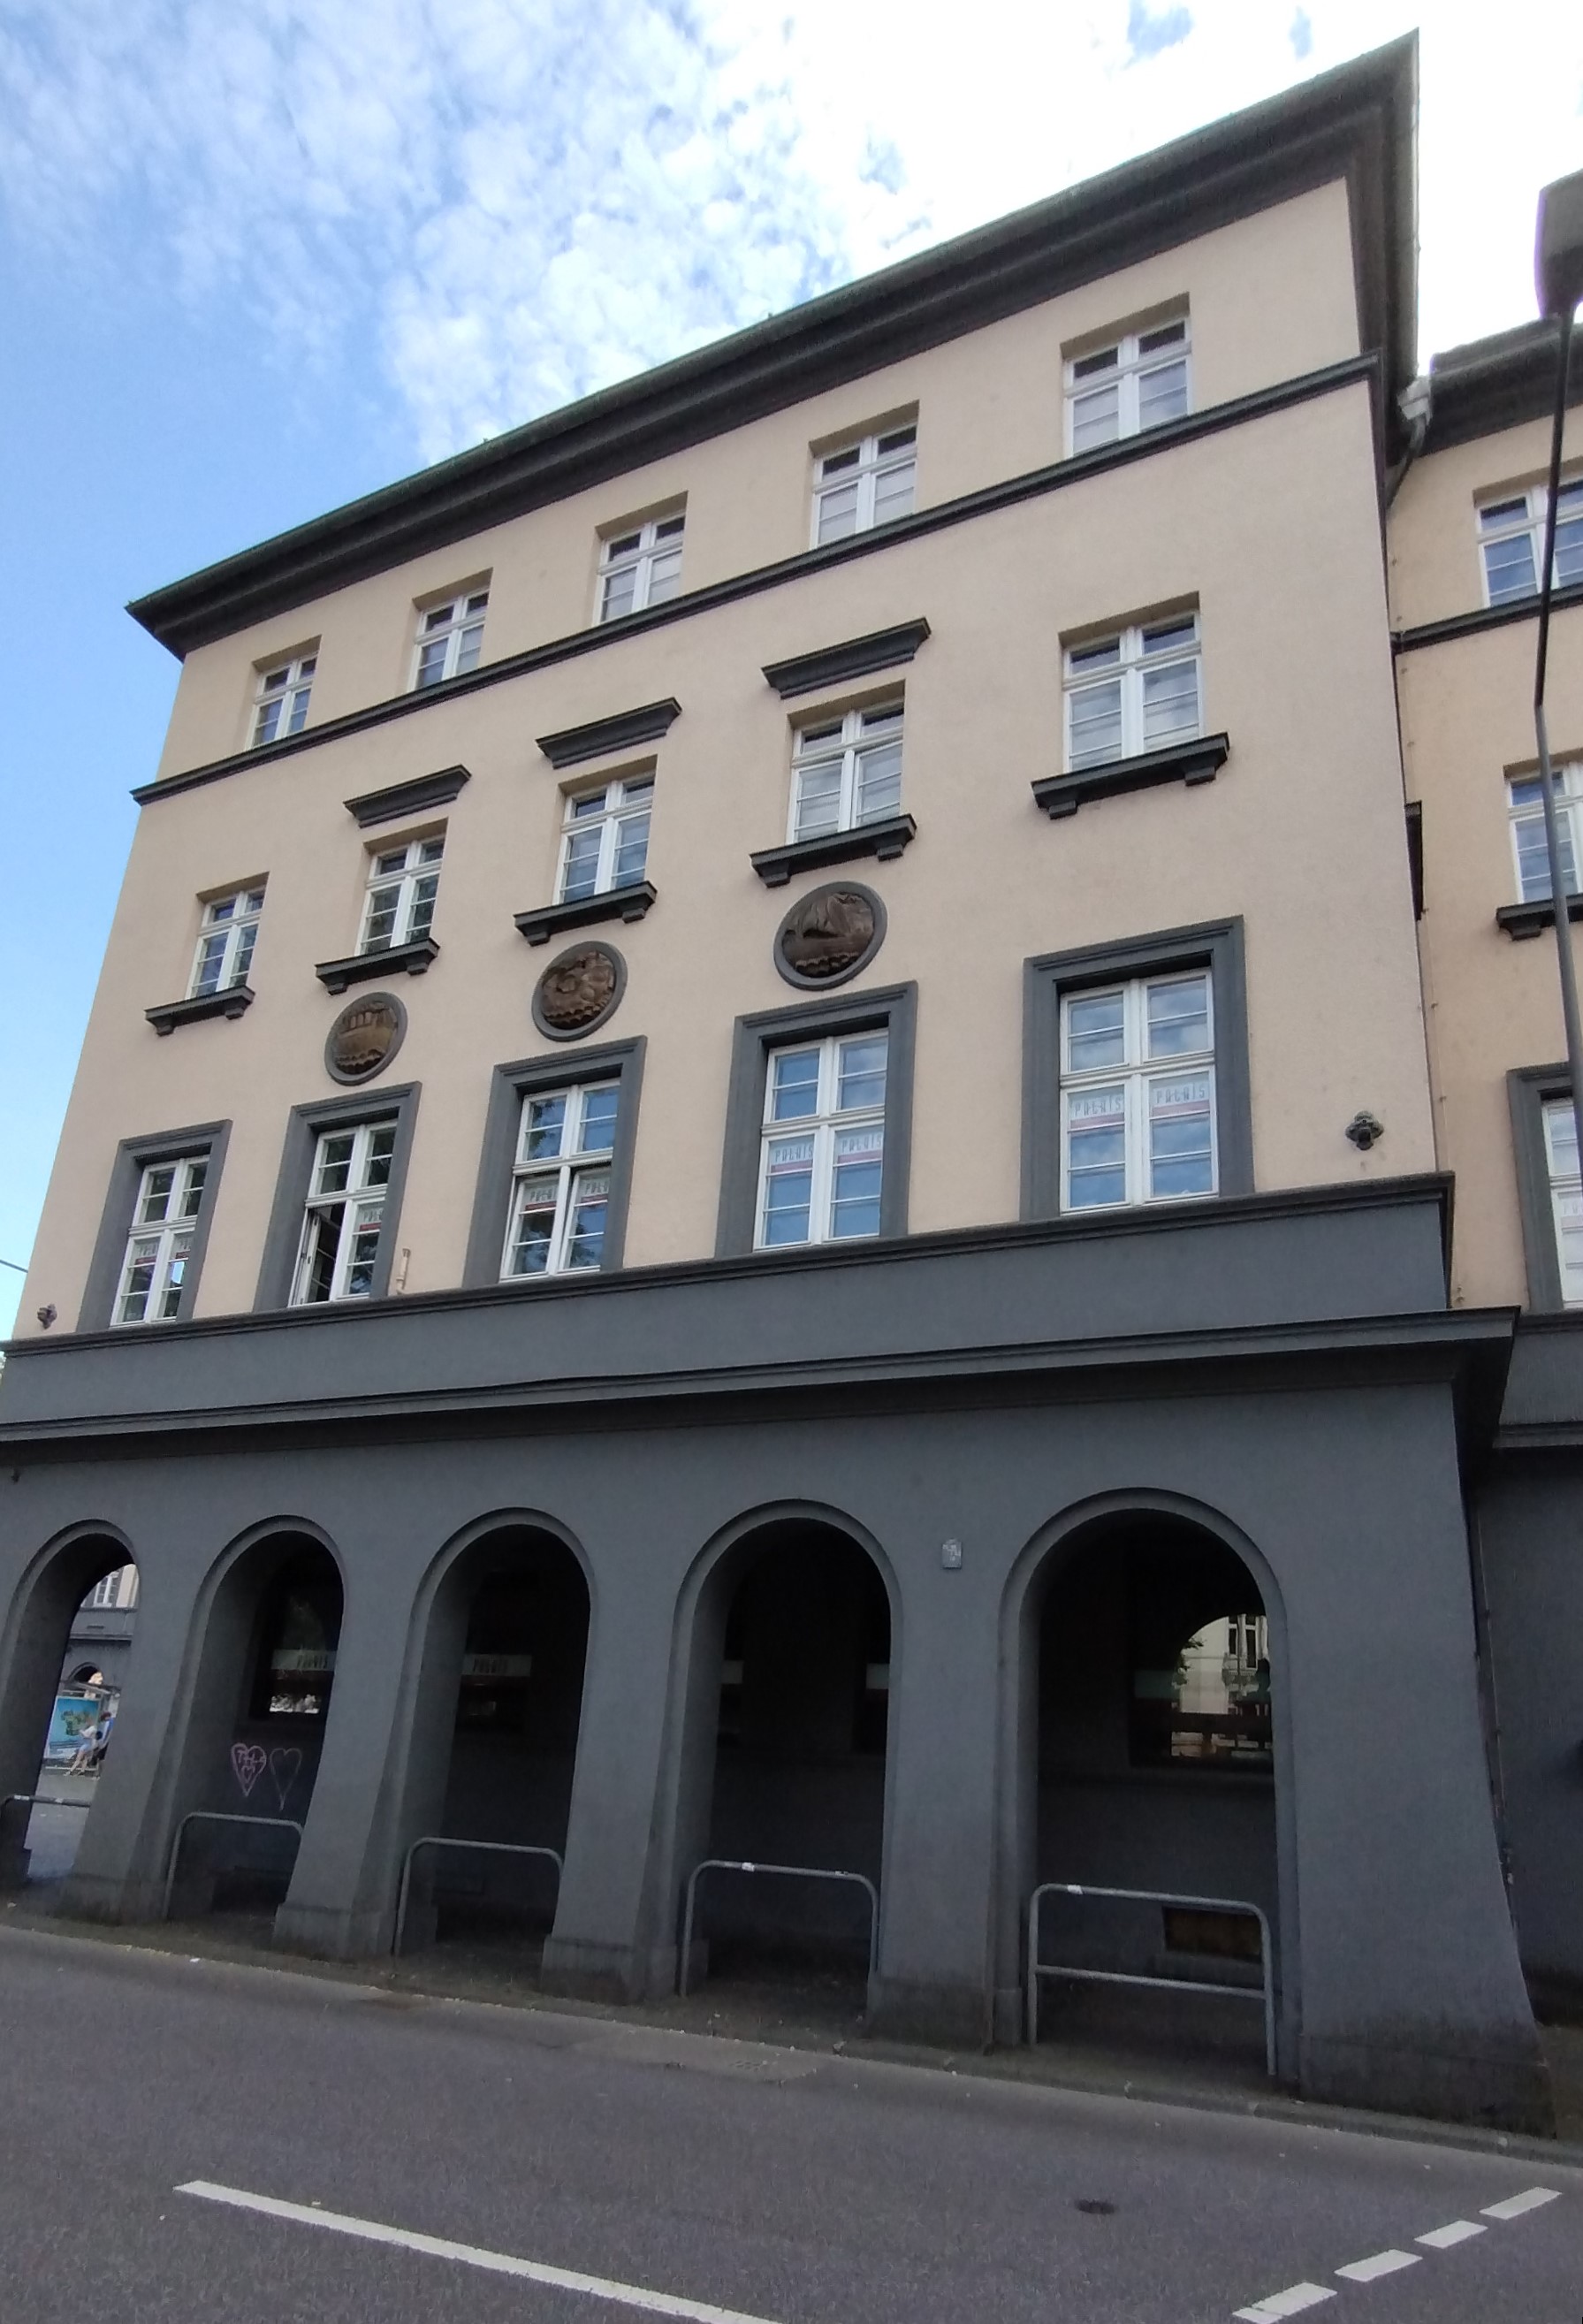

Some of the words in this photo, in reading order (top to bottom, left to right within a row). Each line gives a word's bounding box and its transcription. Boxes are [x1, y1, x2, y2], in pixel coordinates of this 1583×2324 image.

[1157, 1086, 1206, 1104] PALAIS
[1075, 1095, 1123, 1116] PALAIS
[841, 1133, 882, 1153] PALAIS
[775, 1144, 813, 1162] PALAIS
